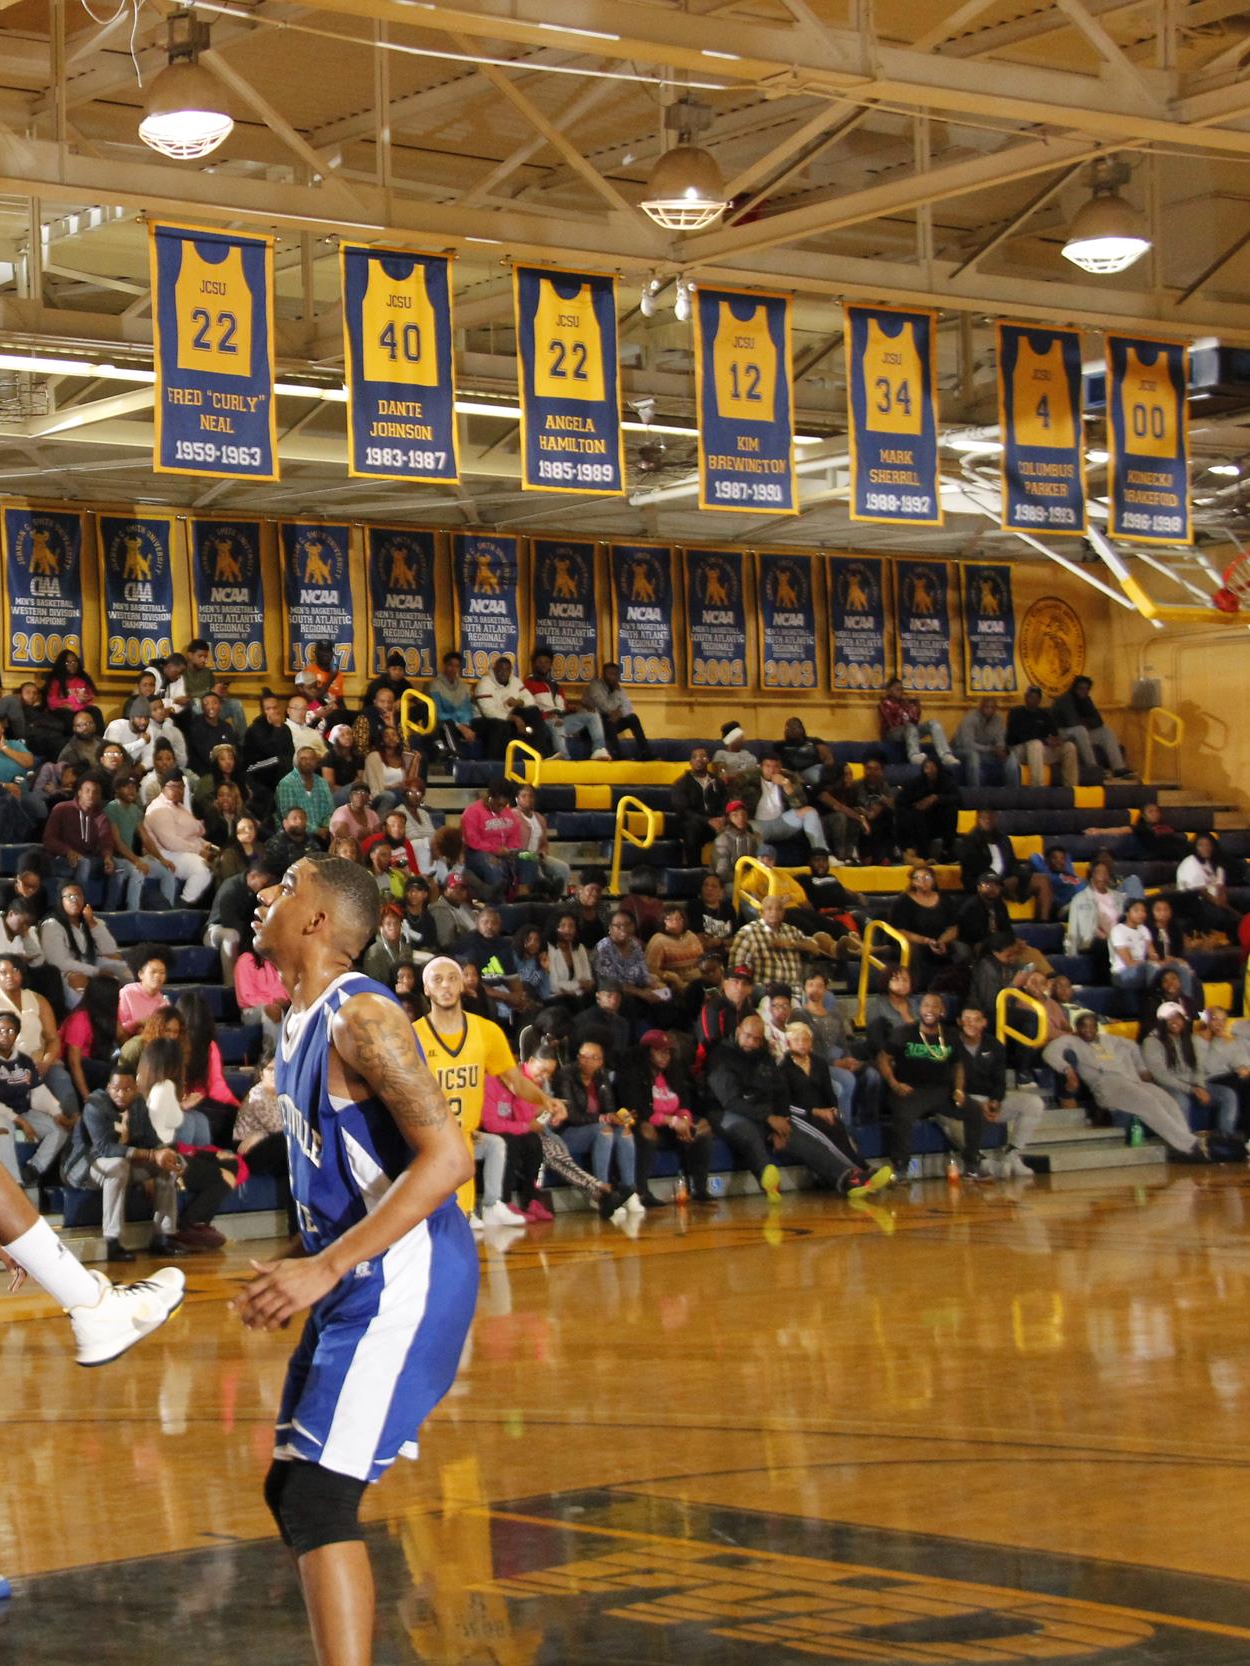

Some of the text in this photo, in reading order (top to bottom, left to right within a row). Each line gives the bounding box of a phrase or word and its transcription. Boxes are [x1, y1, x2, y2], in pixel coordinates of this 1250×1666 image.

[200, 281, 226, 296] JCSU
[386, 294, 412, 309] JCSU
[555, 315, 580, 328] JCSU
[191, 307, 239, 355] 22
[378, 320, 422, 363] 40
[732, 336, 755, 349] JCSU
[549, 339, 589, 381] 22
[729, 362, 762, 402] 12
[167, 388, 202, 406] FRED
[875, 376, 911, 416] 34
[378, 400, 423, 418] DANTE
[1036, 393, 1050, 429] 4
[200, 415, 234, 434] NEAL
[545, 415, 595, 433] ANGELA
[1133, 403, 1165, 440] 00
[370, 422, 433, 441] JOHNSON
[539, 435, 607, 454] HAMILTON
[736, 436, 760, 452] KIM
[175, 440, 261, 467] 1959-1963
[366, 447, 447, 470] 1983-1987
[880, 449, 913, 465] MARK
[538, 460, 614, 482] 1985-1989
[708, 455, 786, 474] BREWINGTON
[1018, 461, 1075, 478] COLUMBUS
[715, 481, 783, 501] 1987-1990
[1024, 481, 1069, 497] PARKER
[211, 587, 249, 602] NCAA
[300, 589, 339, 605] NCAA
[385, 594, 423, 610] NCAA
[11, 606, 48, 616] WESTERN
[469, 598, 507, 614] NCAA
[549, 602, 584, 618] NCAA
[626, 606, 661, 621] NCAA
[26, 616, 67, 625] CHAMPIONS
[108, 610, 171, 621] WESTERN DIVISION
[225, 614, 263, 623] ATLANTIC
[288, 615, 352, 625] SOUTH ATLANTIC
[122, 620, 158, 630] CHAMPIONS
[210, 624, 250, 632] REGIONALS
[300, 624, 339, 634] REGIONALS
[383, 628, 423, 638] REGIONALS
[468, 633, 507, 642] REGIONALS
[205, 641, 263, 671] 1960
[293, 642, 352, 671] 197
[551, 653, 595, 680] 995
